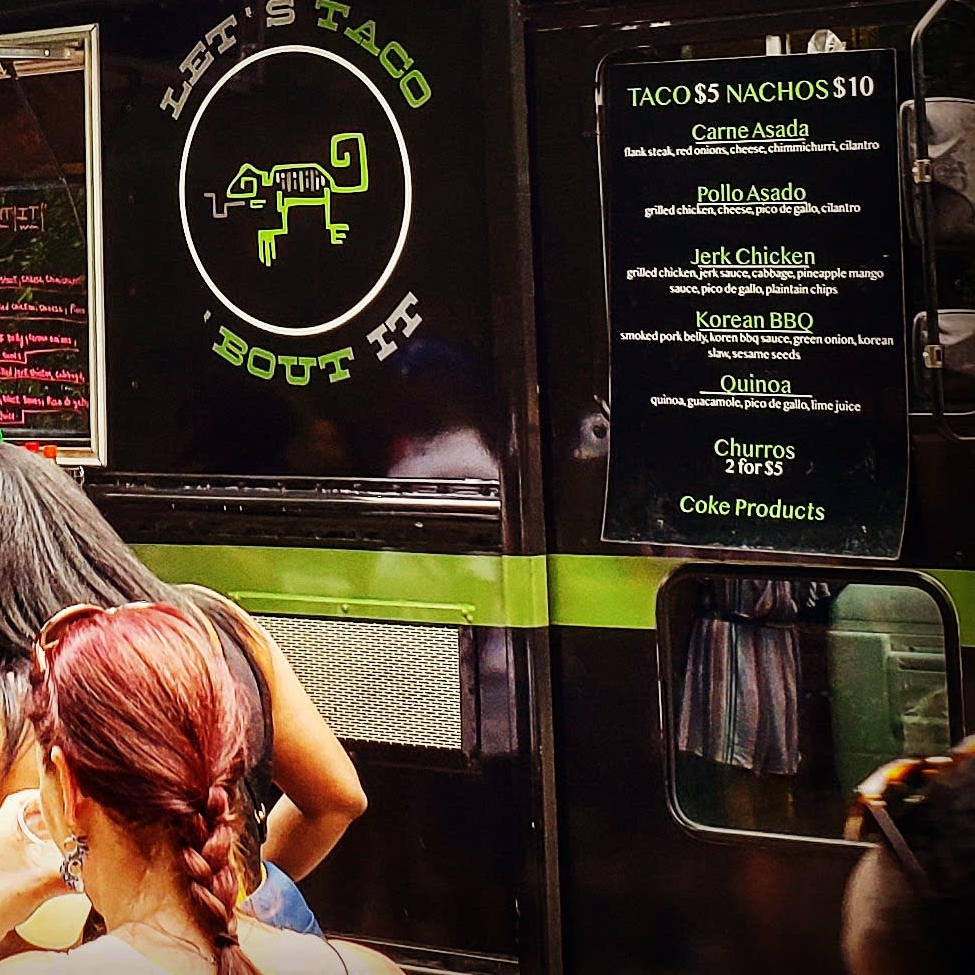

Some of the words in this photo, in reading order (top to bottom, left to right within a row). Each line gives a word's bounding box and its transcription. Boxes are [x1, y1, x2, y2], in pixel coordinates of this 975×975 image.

[627, 86, 691, 106] TACO
[694, 82, 720, 104] $5
[726, 79, 829, 103] NACHOS
[832, 75, 874, 99] $10
[691, 123, 749, 141] Carne
[752, 118, 809, 139] Asada
[624, 146, 646, 157] flank
[647, 145, 675, 157] steak,
[676, 145, 692, 156] red
[694, 144, 729, 156] onions,
[730, 143, 767, 155] cheese,
[768, 140, 839, 153] chimmichurri,
[840, 140, 880, 152] cilantro
[697, 184, 744, 203] Pollo
[746, 182, 807, 202] Asado
[644, 205, 675, 218] grilled
[676, 205, 716, 216] chicken,
[717, 205, 754, 215] cheese,
[755, 203, 778, 216] pico
[779, 204, 792, 214] de
[793, 203, 820, 216] gallo,
[821, 202, 861, 214] cilantro
[690, 246, 732, 265] Jerk
[735, 245, 816, 266] Chicken
[626, 267, 658, 280] grilled
[658, 267, 697, 278] chicken,
[697, 268, 719, 280] jerk
[720, 269, 751, 279] sauce,
[752, 268, 796, 280] cabbage,
[797, 268, 847, 281] pineapple
[848, 269, 885, 281] mango
[669, 284, 700, 295] sauce,
[701, 283, 723, 296] pico
[724, 283, 737, 294] de
[738, 283, 764, 296] gallo,
[765, 283, 809, 296] plaintain
[810, 283, 839, 297] chips
[366, 291, 423, 362] IT
[696, 310, 765, 329] Korean
[769, 311, 814, 333] BBQ
[620, 330, 658, 341] smoked
[659, 330, 682, 343] pork
[683, 331, 709, 344] belly,
[710, 332, 738, 342] koren
[739, 333, 760, 345] bbq
[760, 335, 792, 345] sauce,
[793, 334, 823, 346] green
[824, 334, 857, 346] onion,
[858, 334, 894, 346] korean
[707, 347, 732, 359] slaw,
[732, 350, 770, 360] sesame
[771, 349, 801, 360] seeds
[720, 373, 792, 394] Quinoa
[650, 394, 686, 406] quinoa,
[687, 396, 743, 409] guacamole,
[744, 397, 767, 410] pico
[768, 398, 781, 409] de
[782, 398, 810, 412] gallo,
[811, 399, 833, 411] lime
[833, 399, 861, 413] juice
[713, 437, 796, 459] Churros
[725, 458, 735, 474] 2
[737, 457, 762, 475] for
[764, 460, 784, 476] $5
[679, 495, 731, 515] Coke
[734, 498, 826, 521] Products
